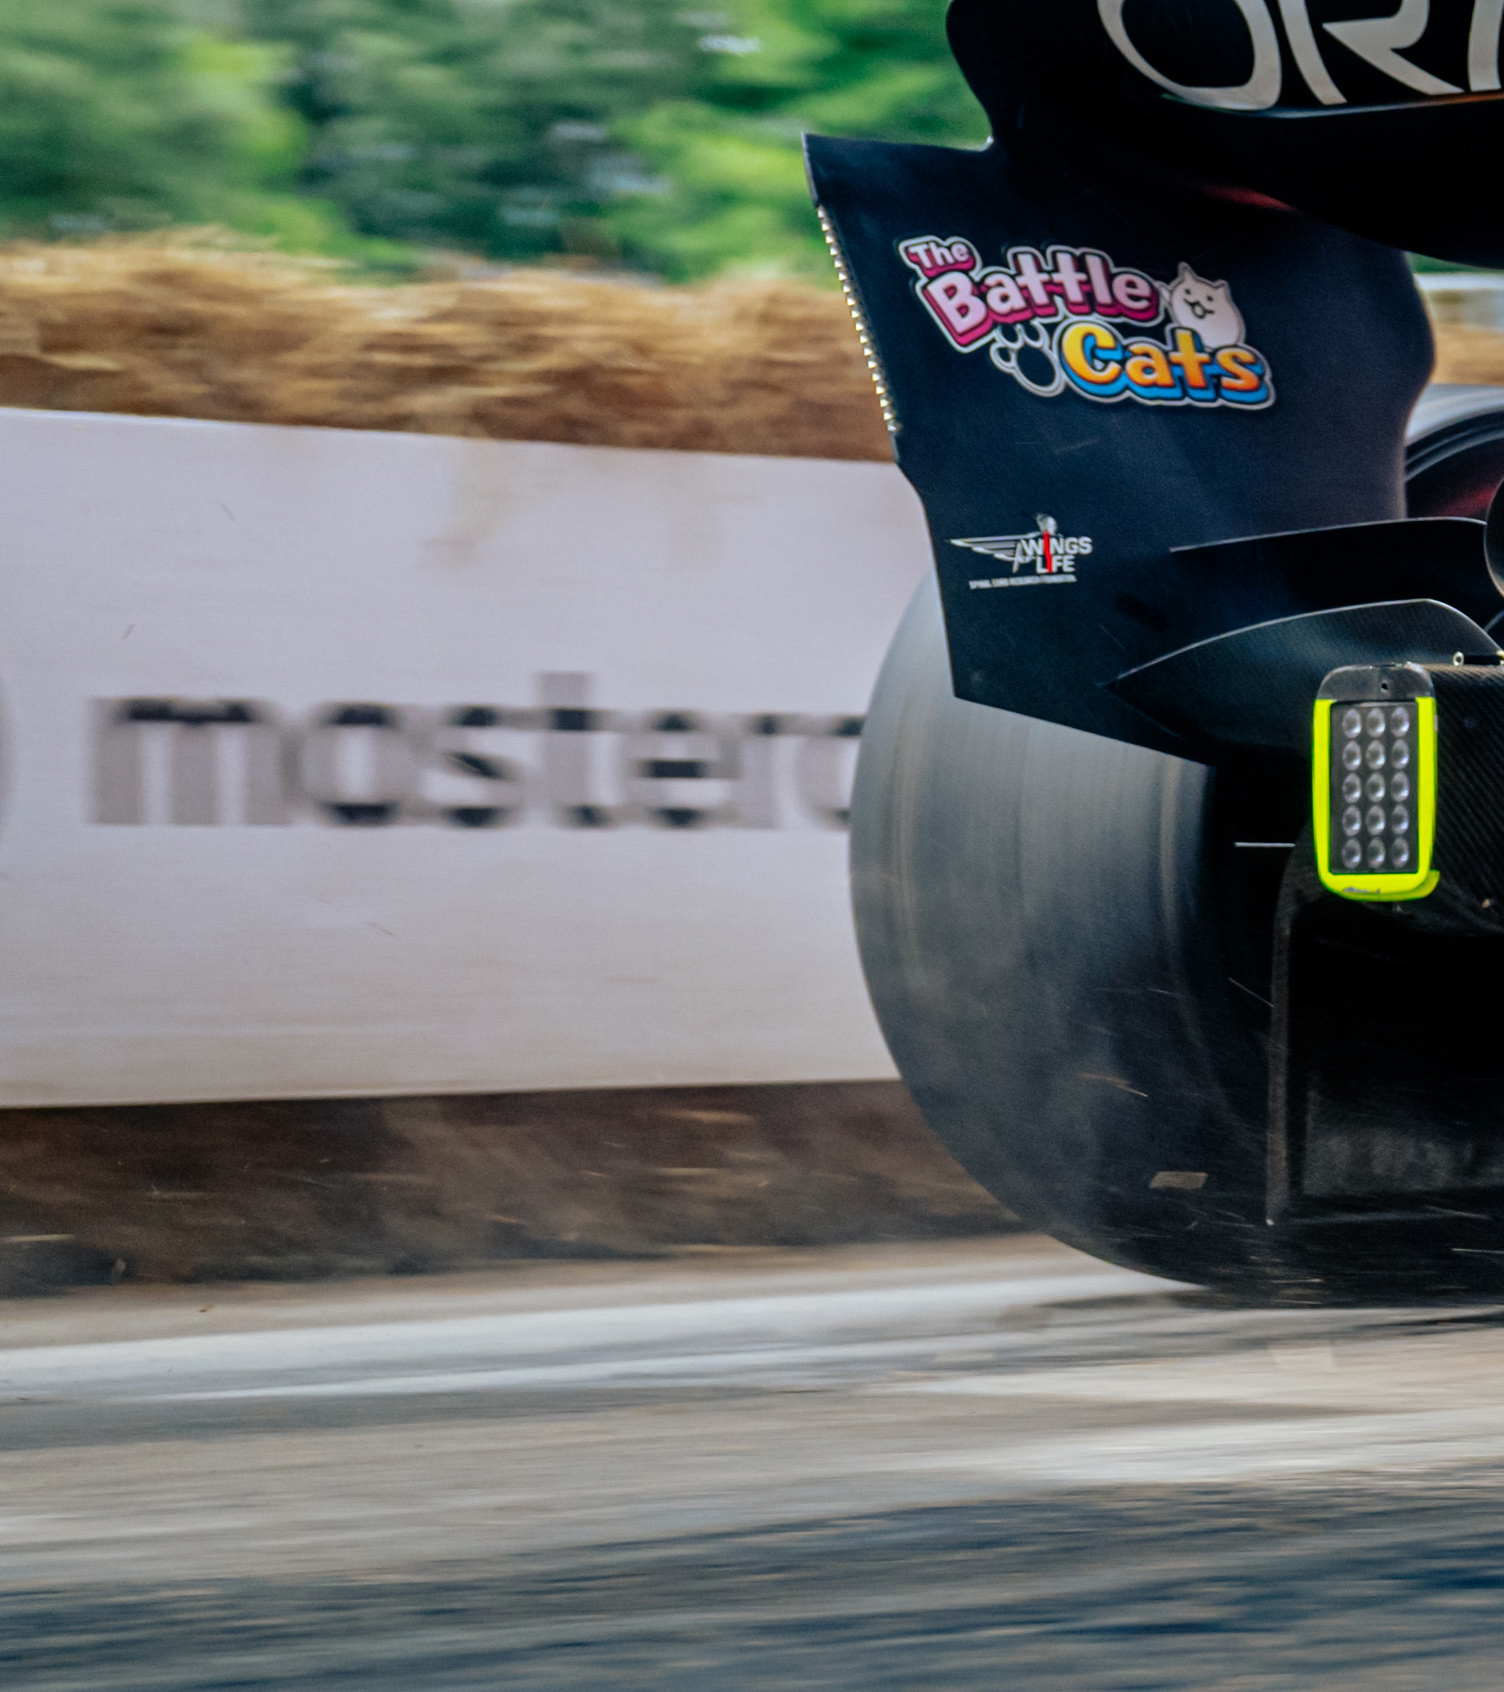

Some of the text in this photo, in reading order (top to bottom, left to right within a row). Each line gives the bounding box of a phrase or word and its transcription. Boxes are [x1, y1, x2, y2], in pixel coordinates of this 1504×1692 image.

[909, 241, 970, 270] The
[925, 251, 1160, 346] Battle
[1060, 320, 1266, 402] Cats
[1020, 534, 1094, 556] WINGS
[1036, 554, 1076, 575] LIFE
